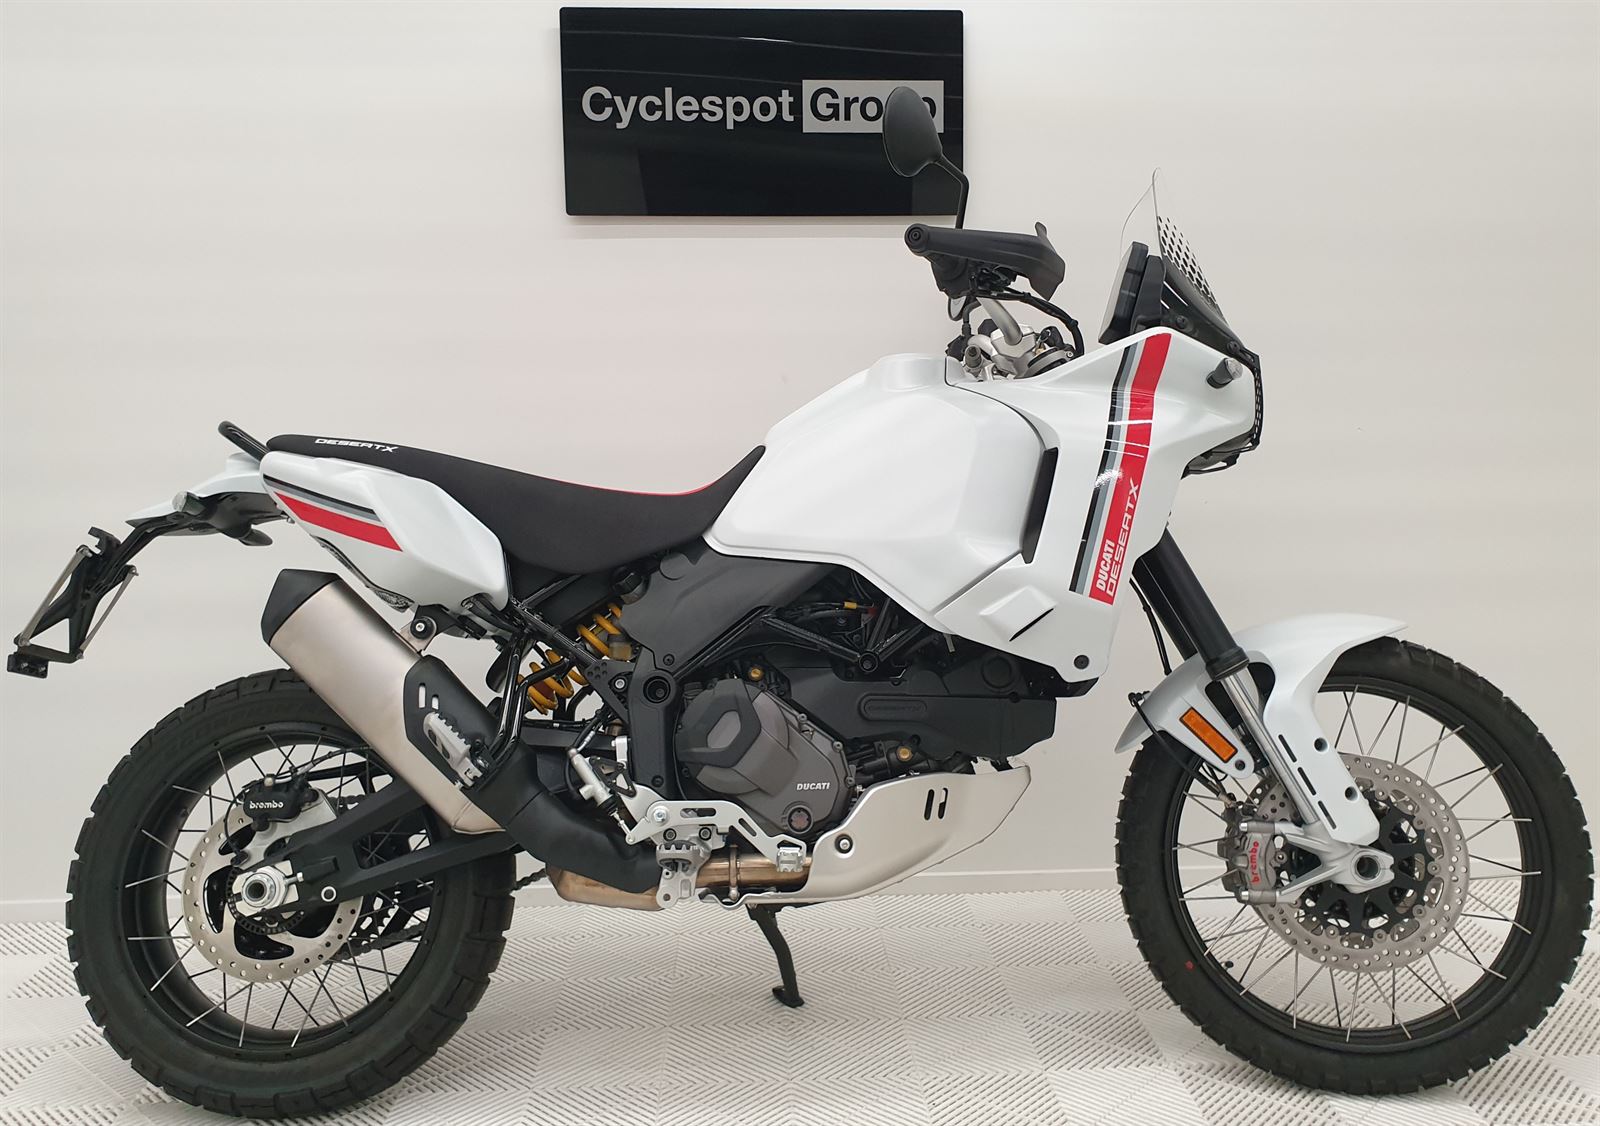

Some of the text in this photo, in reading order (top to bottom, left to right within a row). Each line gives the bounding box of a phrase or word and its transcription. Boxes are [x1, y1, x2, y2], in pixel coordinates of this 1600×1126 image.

[581, 86, 937, 130] Cyclespot Gro
[314, 437, 399, 453] DESERTX
[1105, 477, 1139, 597] DESERTX
[1095, 538, 1116, 592] DUCATI
[249, 800, 284, 809] brembo
[796, 782, 831, 791] DUCATI
[1250, 840, 1261, 883] brembo
